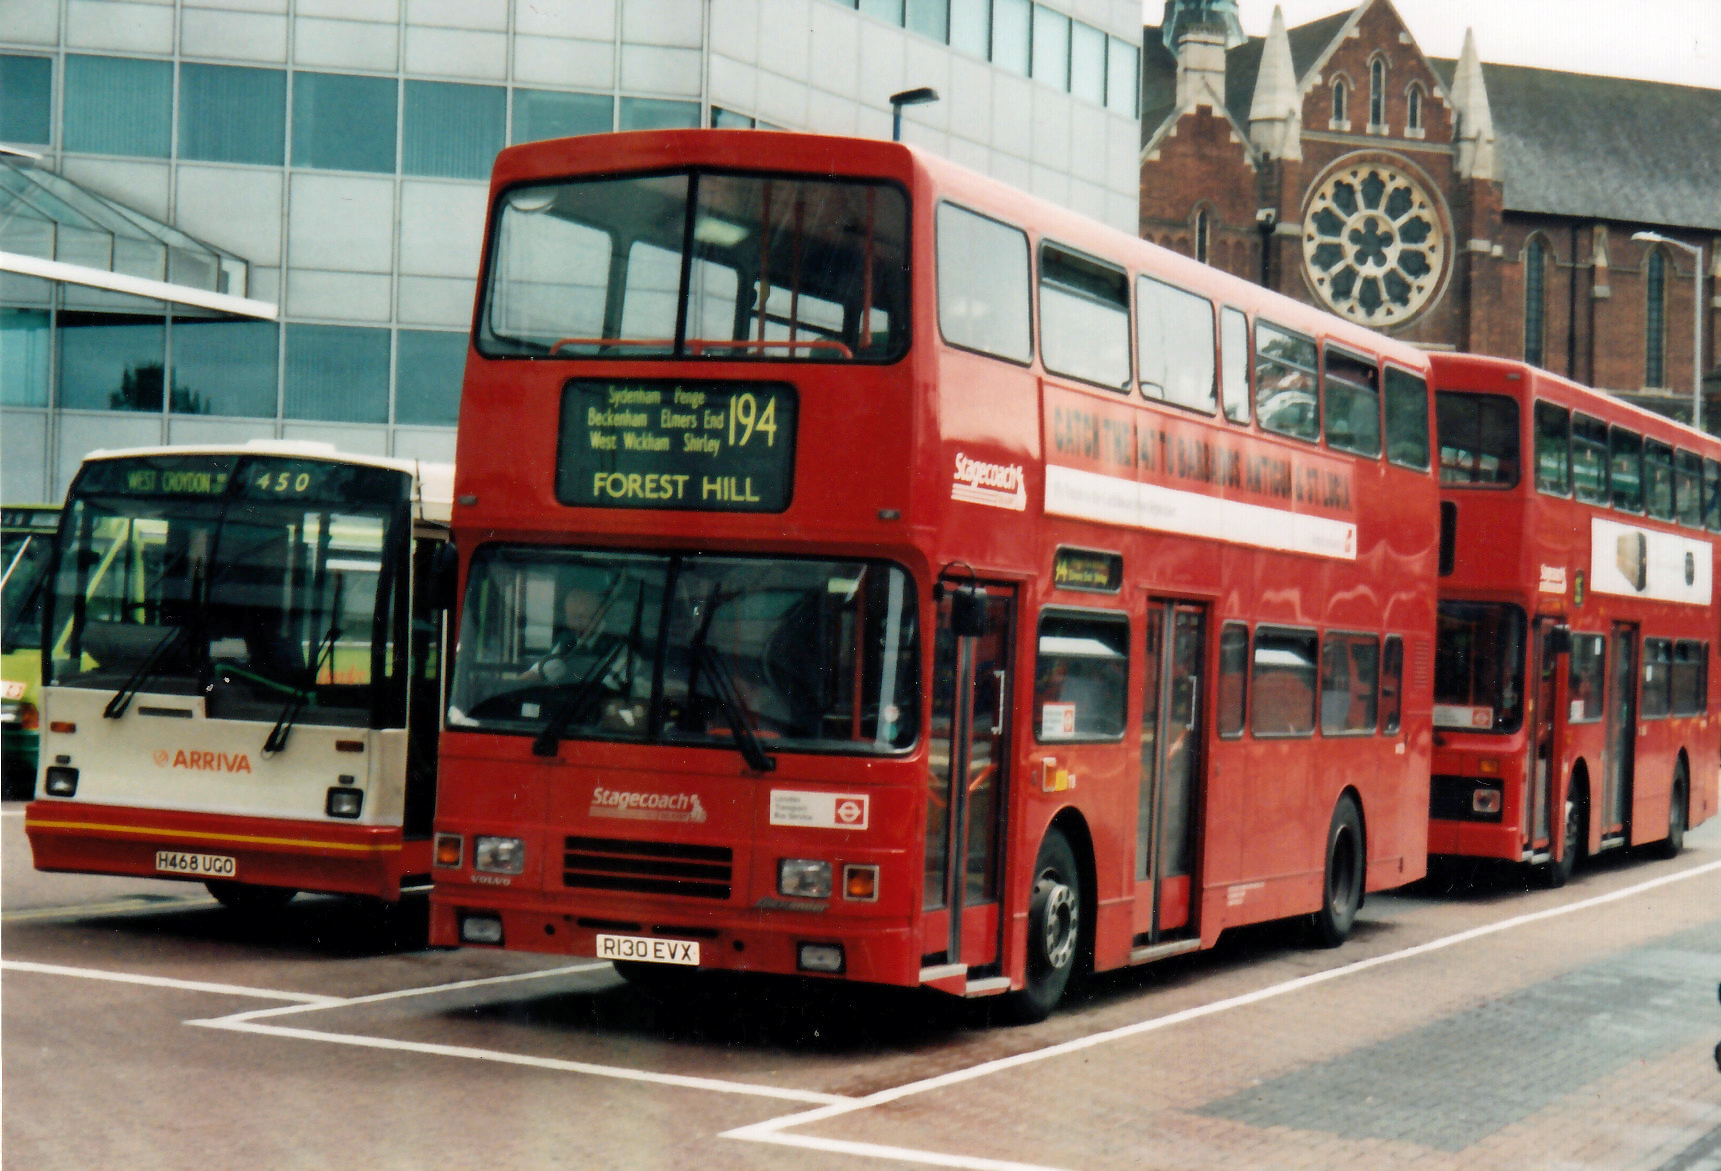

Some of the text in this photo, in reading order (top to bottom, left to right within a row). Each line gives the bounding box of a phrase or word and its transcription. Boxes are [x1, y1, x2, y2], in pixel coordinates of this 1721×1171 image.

[609, 385, 705, 409] Sydenham Penge
[588, 407, 724, 429] Beckenham Elmers End
[728, 392, 777, 447] 194
[590, 431, 721, 457] West Wickham Shirley
[128, 470, 156, 491] WEST
[162, 471, 211, 493] CROYDON
[256, 472, 310, 492] 450
[953, 452, 1017, 490] Stagecoach
[594, 472, 760, 502] FOREST HILL
[173, 749, 252, 774] ARRIVA
[592, 787, 689, 811] Stagecoach
[157, 852, 199, 871] H468
[470, 875, 511, 886] VOLVO
[603, 937, 692, 961] R130 EVX
